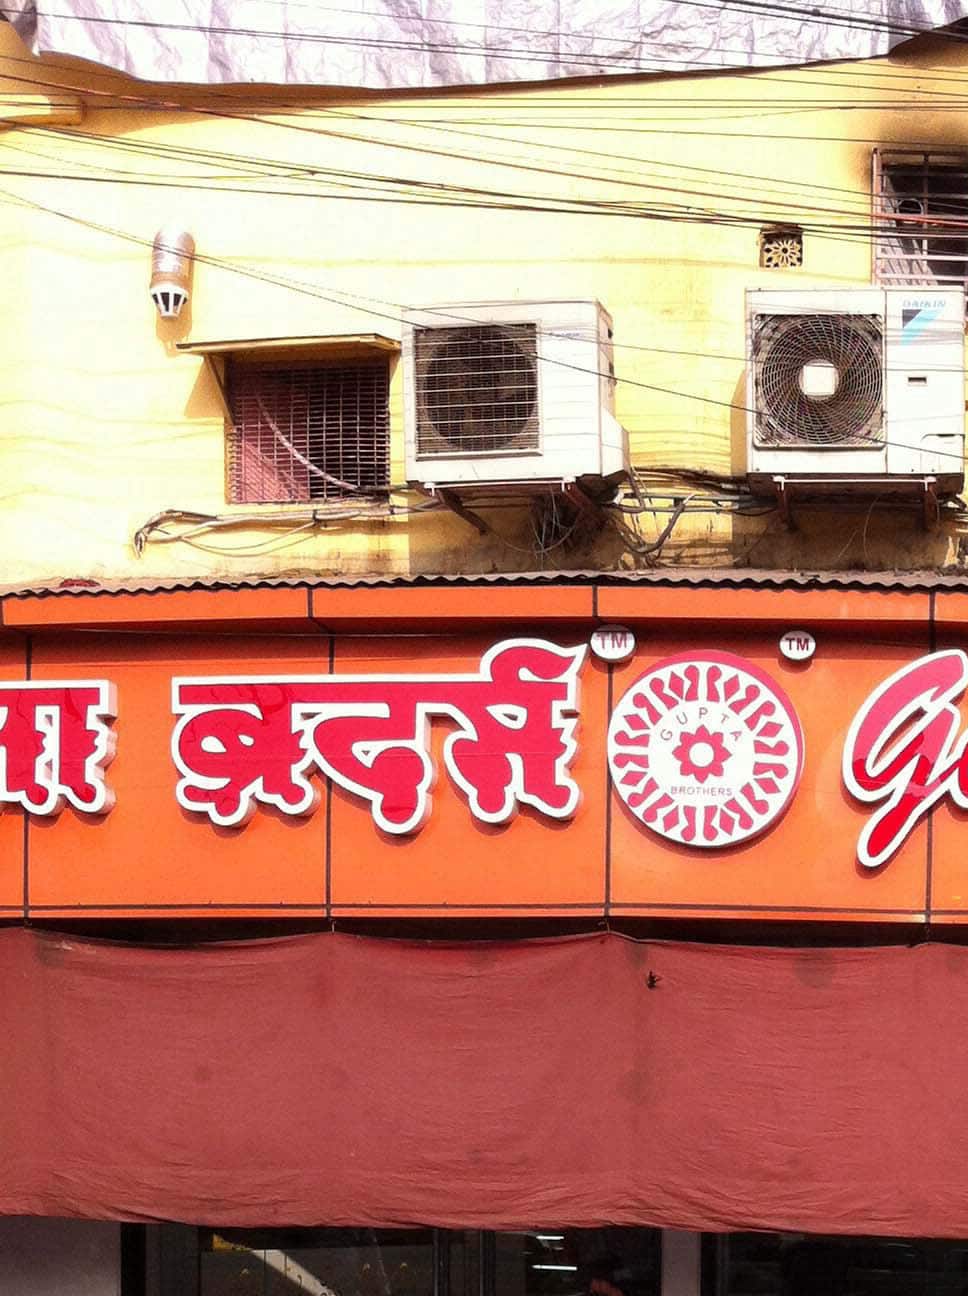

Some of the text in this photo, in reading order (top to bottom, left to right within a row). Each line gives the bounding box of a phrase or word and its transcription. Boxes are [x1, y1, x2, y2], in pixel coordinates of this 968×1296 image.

[595, 632, 628, 649] TM
[785, 637, 810, 652] TM
[659, 706, 743, 742] GUPTA
[670, 785, 733, 797] BROTHERS
